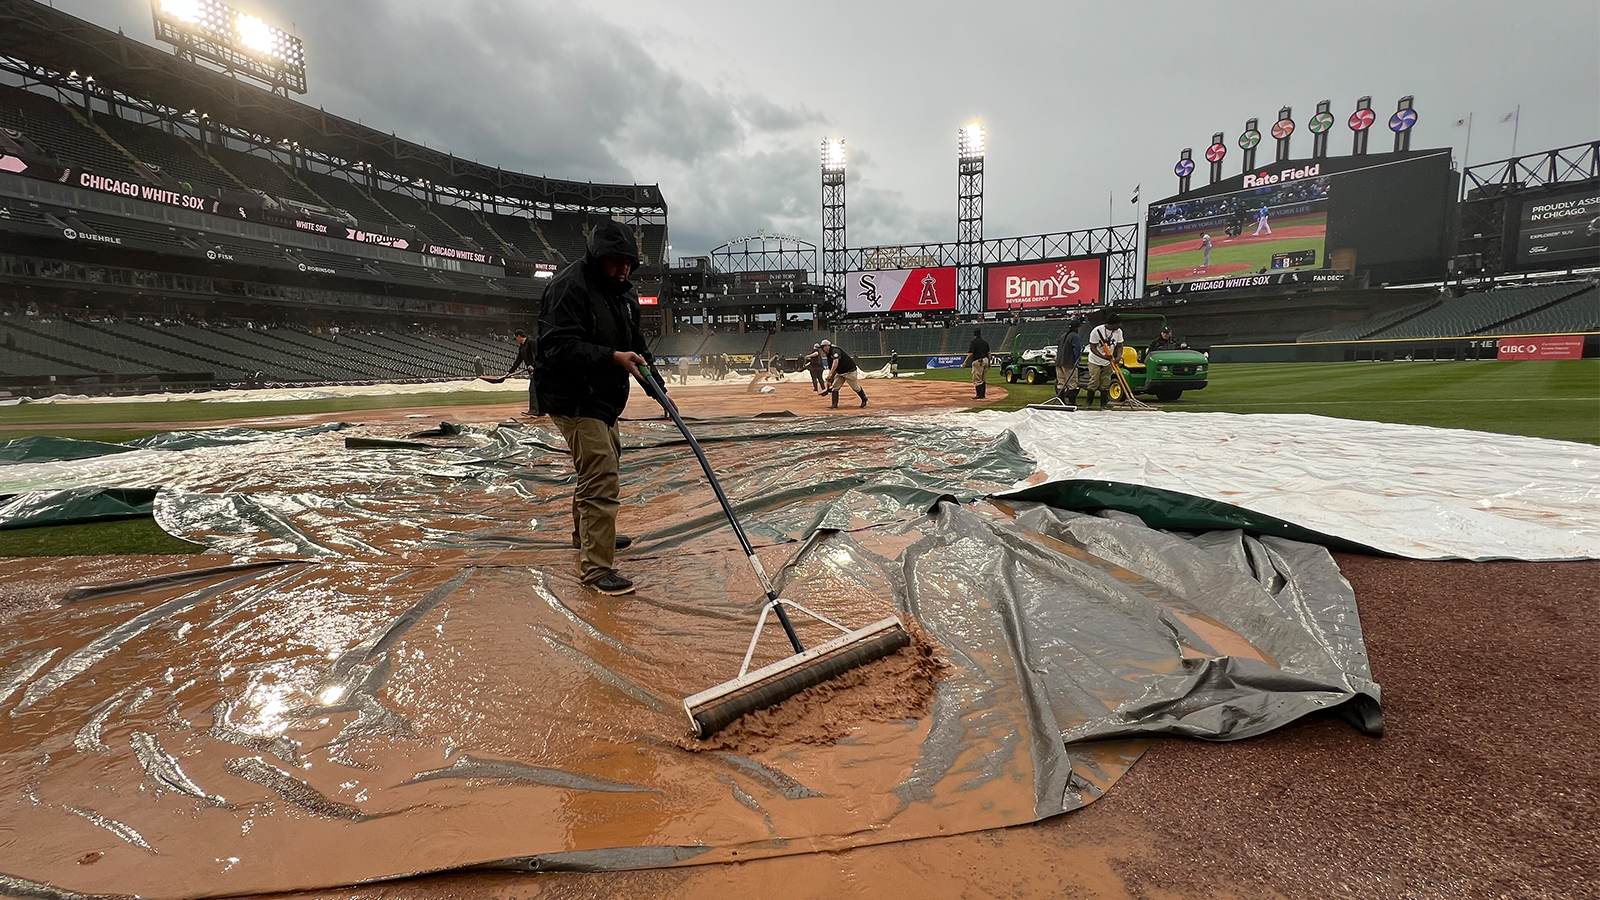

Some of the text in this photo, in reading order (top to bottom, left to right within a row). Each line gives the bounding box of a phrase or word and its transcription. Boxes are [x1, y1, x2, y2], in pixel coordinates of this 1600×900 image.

[1243, 163, 1320, 189] Rate Field
[80, 173, 205, 210] CHICAGO WHITE SOX
[1532, 201, 1576, 213] PROUDLY
[1543, 207, 1587, 219] CHICAGO.
[296, 220, 315, 231] WHITE
[315, 224, 327, 233] SOX
[1198, 220, 1214, 228] YORK
[79, 232, 121, 245] BUEHRLE
[727, 235, 752, 247] KIDS
[772, 233, 802, 245] ZONE
[429, 245, 486, 263] CHICAGO WHITE SOX
[918, 273, 939, 305] A
[1006, 270, 1080, 299] Binny's
[1190, 275, 1270, 291] CHICAGO WHITE SOX
[905, 311, 922, 319] Modelo
[1500, 345, 1525, 353] CIBC
